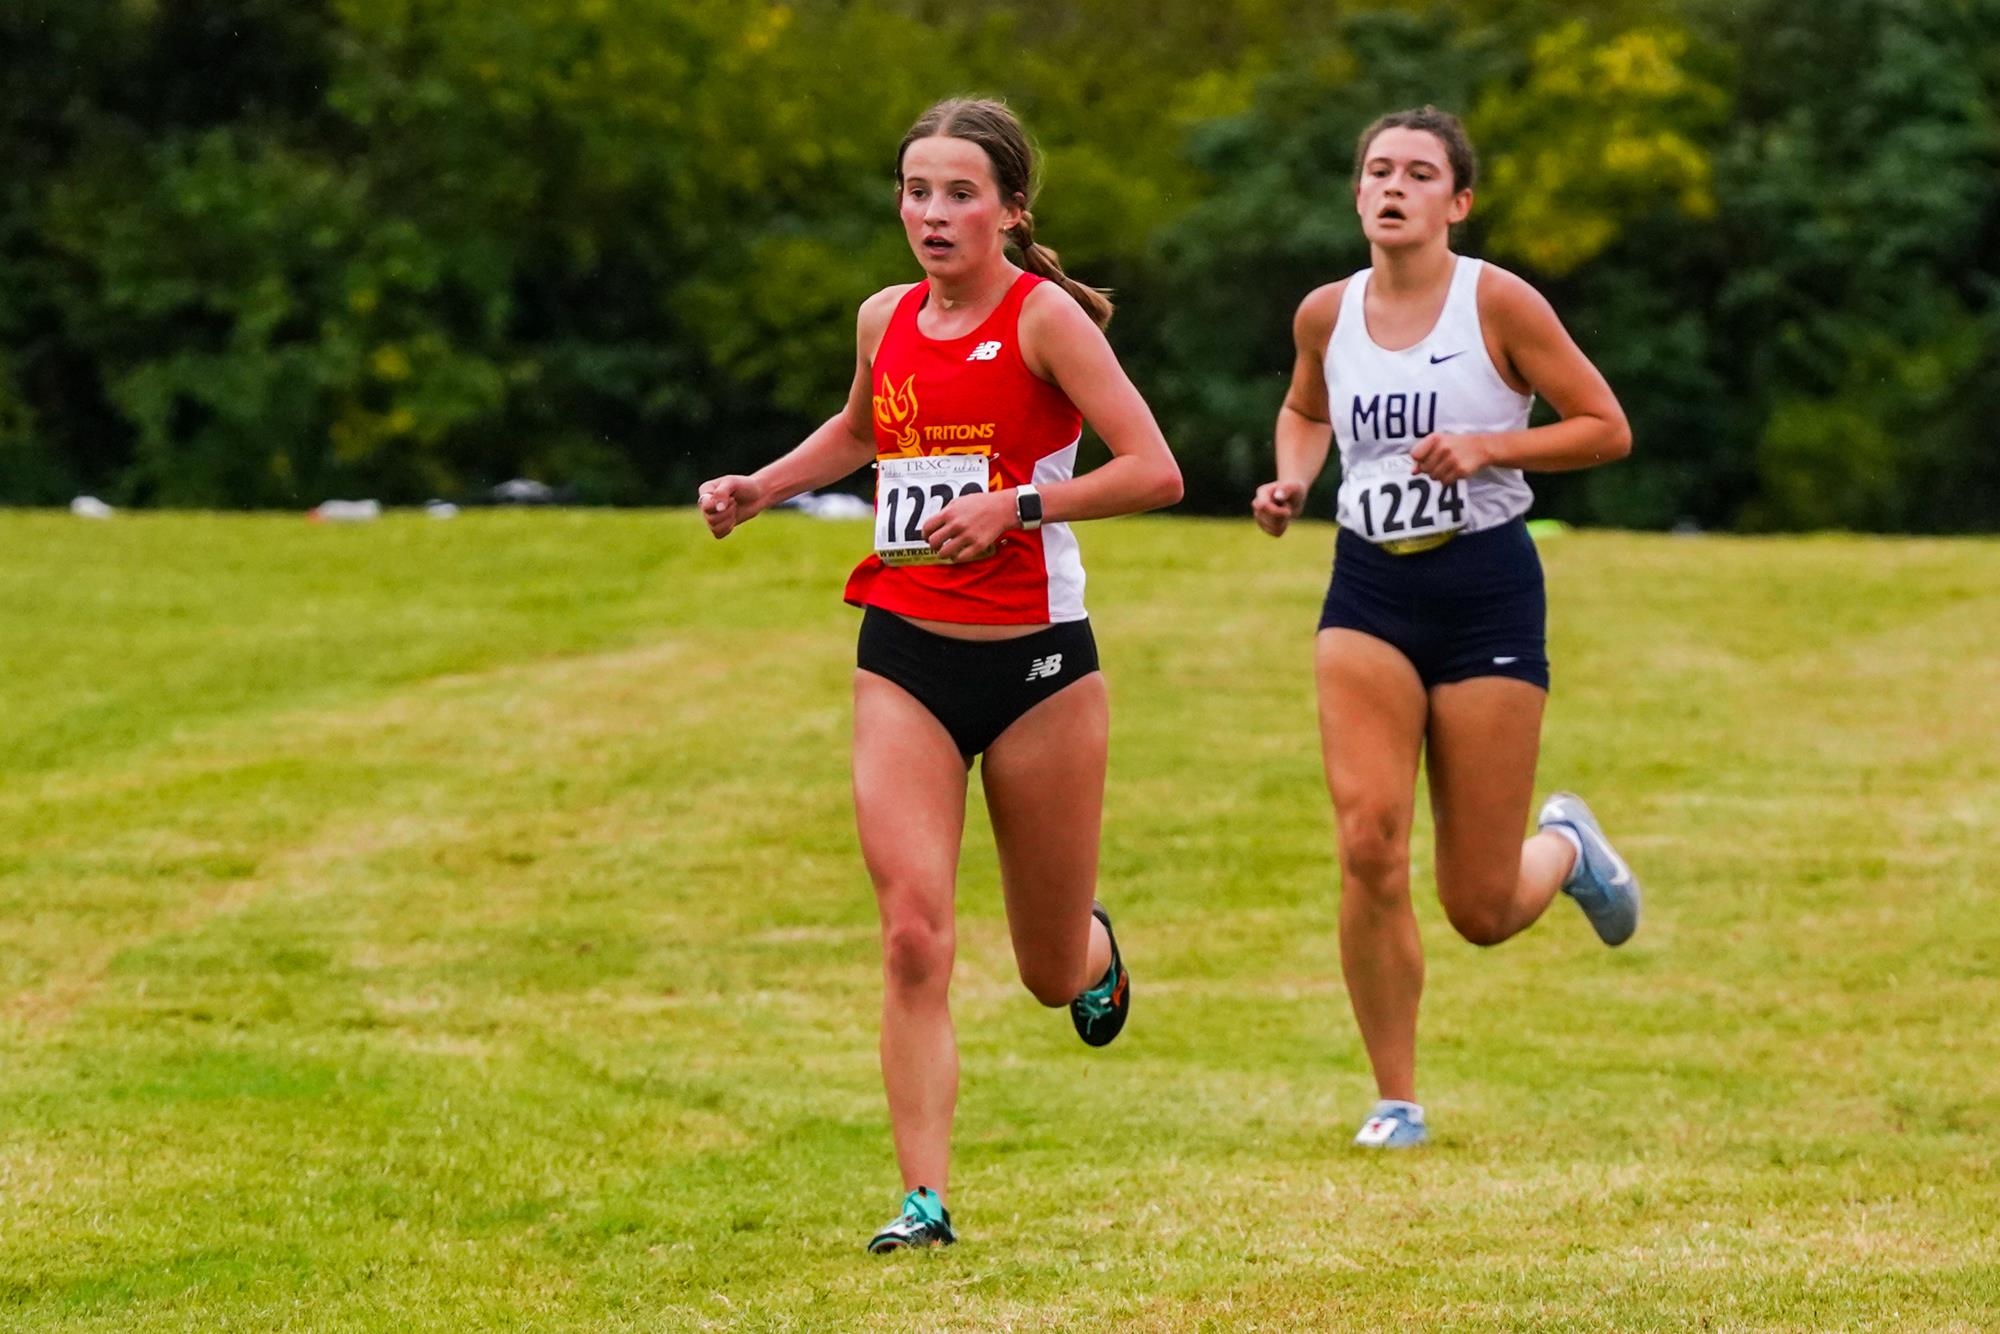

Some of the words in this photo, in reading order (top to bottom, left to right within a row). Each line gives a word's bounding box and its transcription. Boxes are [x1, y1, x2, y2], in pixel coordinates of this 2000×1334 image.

[924, 423, 995, 440] TRITONS
[1352, 392, 1437, 441] MBU
[903, 458, 952, 473] TRXC
[886, 482, 984, 542] 122
[1359, 478, 1465, 536] 1224
